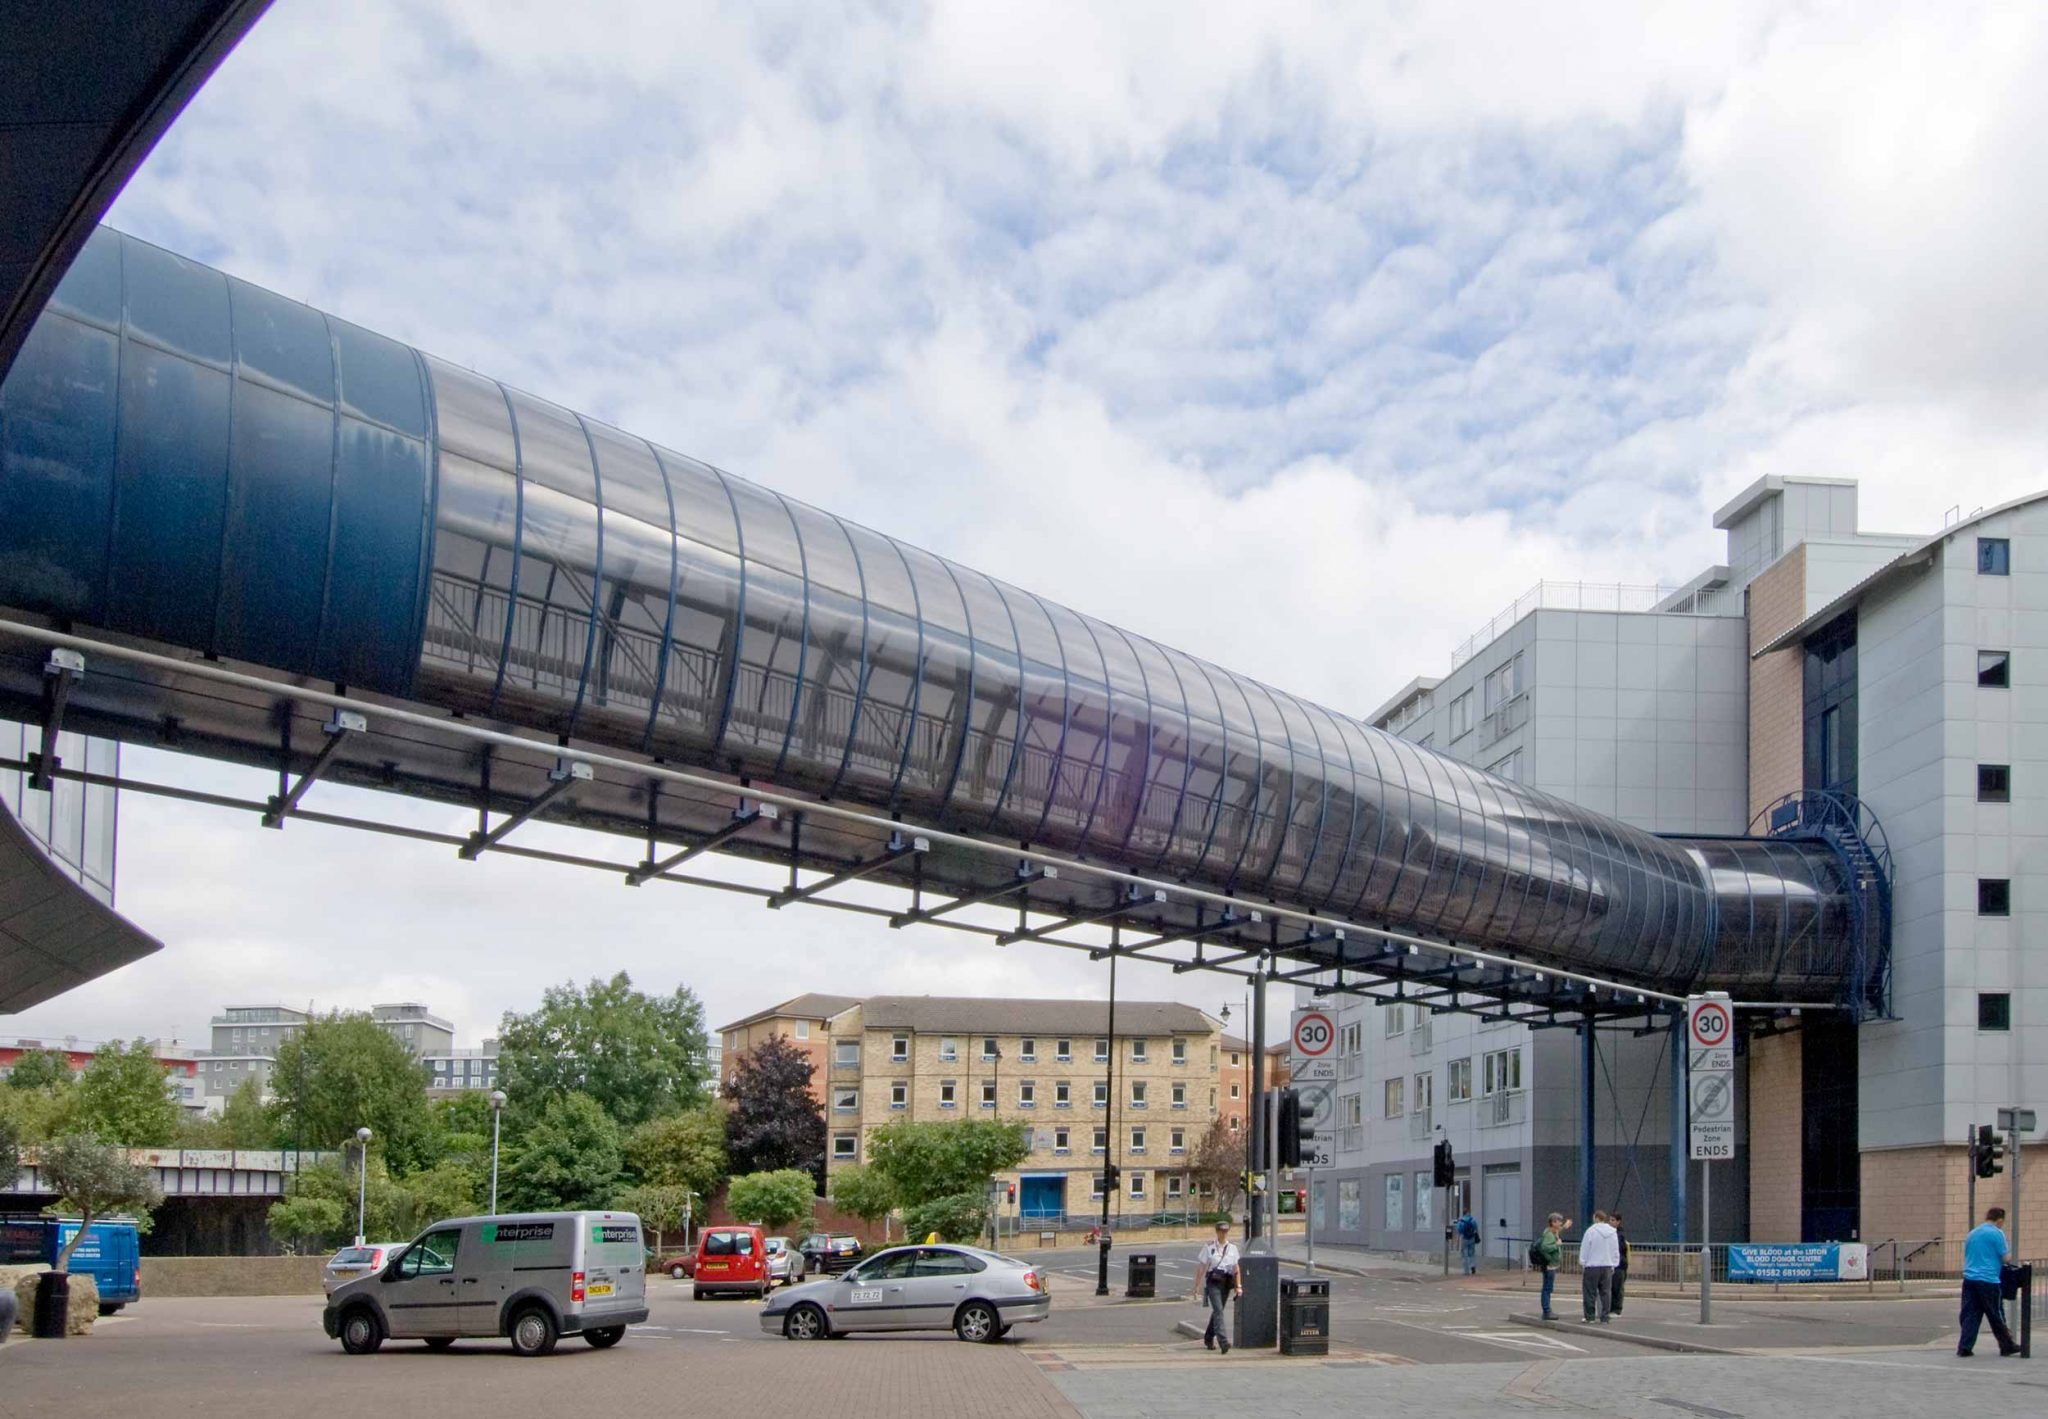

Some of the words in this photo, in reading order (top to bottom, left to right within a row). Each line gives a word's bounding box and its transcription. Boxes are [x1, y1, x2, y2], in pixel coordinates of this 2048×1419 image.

[1698, 1015, 1723, 1033] 30
[1301, 1025, 1328, 1043] 30
[1711, 1060, 1731, 1068] ENDS
[1313, 1069, 1334, 1077] ENDS
[1693, 1125, 1731, 1133] Pedestrian
[1703, 1134, 1721, 1142] Zone
[1696, 1145, 1728, 1156] ENDS
[487, 1226, 552, 1239] nterprise
[1756, 1269, 1781, 1277] 01582
